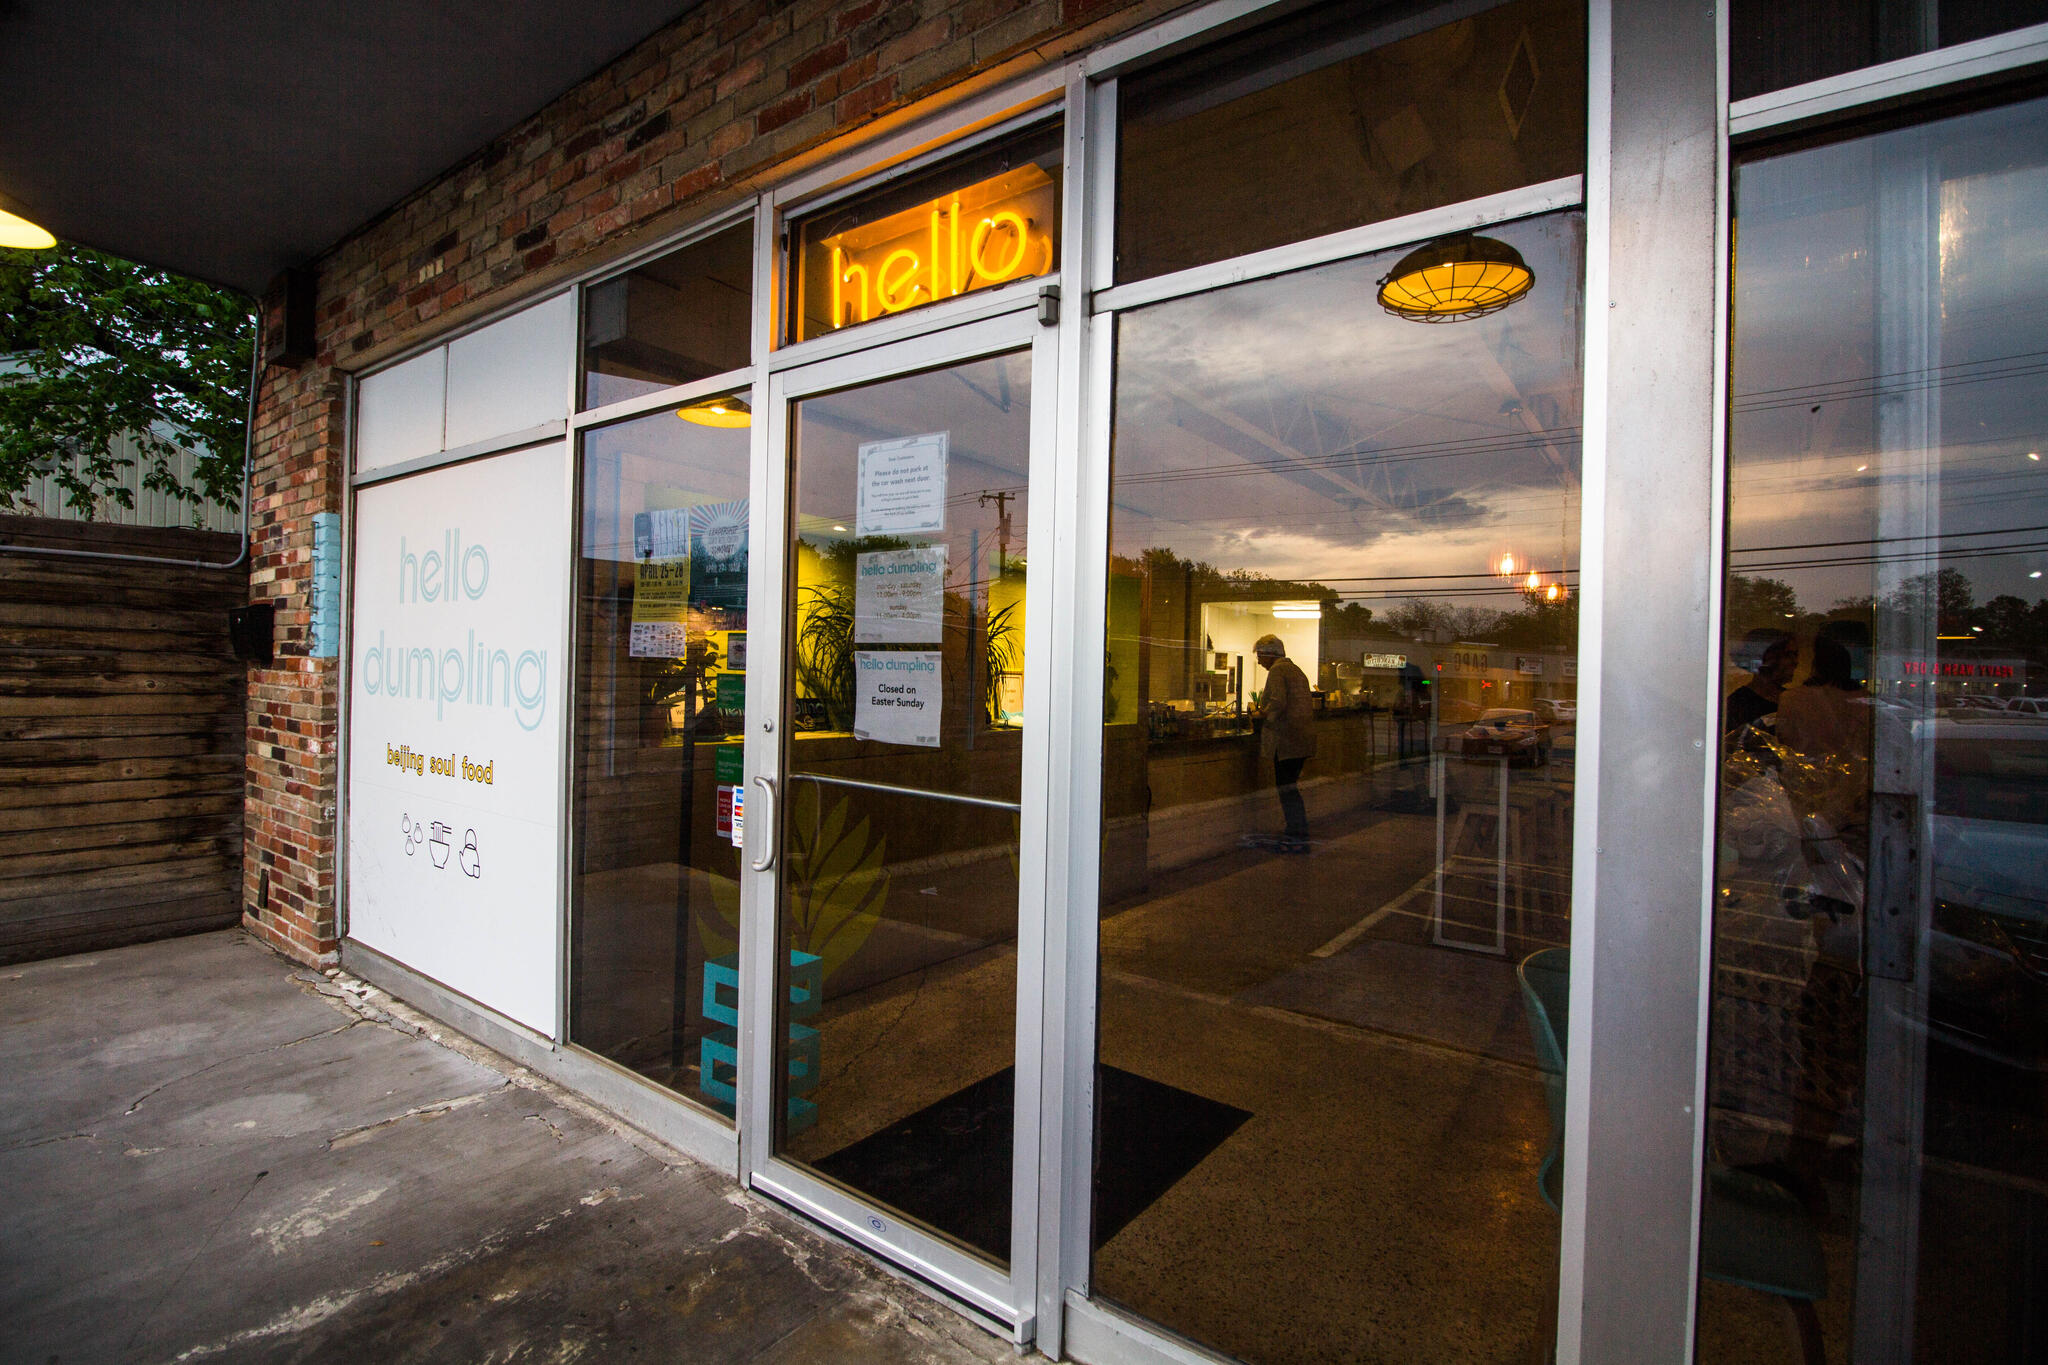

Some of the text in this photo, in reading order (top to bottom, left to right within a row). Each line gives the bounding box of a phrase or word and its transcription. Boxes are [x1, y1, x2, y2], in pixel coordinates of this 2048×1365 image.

[832, 201, 1028, 329] hello
[910, 465, 921, 475] park
[891, 478, 904, 486] wash
[400, 528, 489, 603] hello
[640, 563, 658, 579] APRIL
[861, 560, 937, 577] hello dumpling
[860, 657, 935, 673] hello dumpling
[363, 628, 547, 731] dumpling
[878, 683, 916, 694] Closed on
[871, 696, 925, 710] Easter Sunday
[387, 743, 494, 785] beijing soul food
